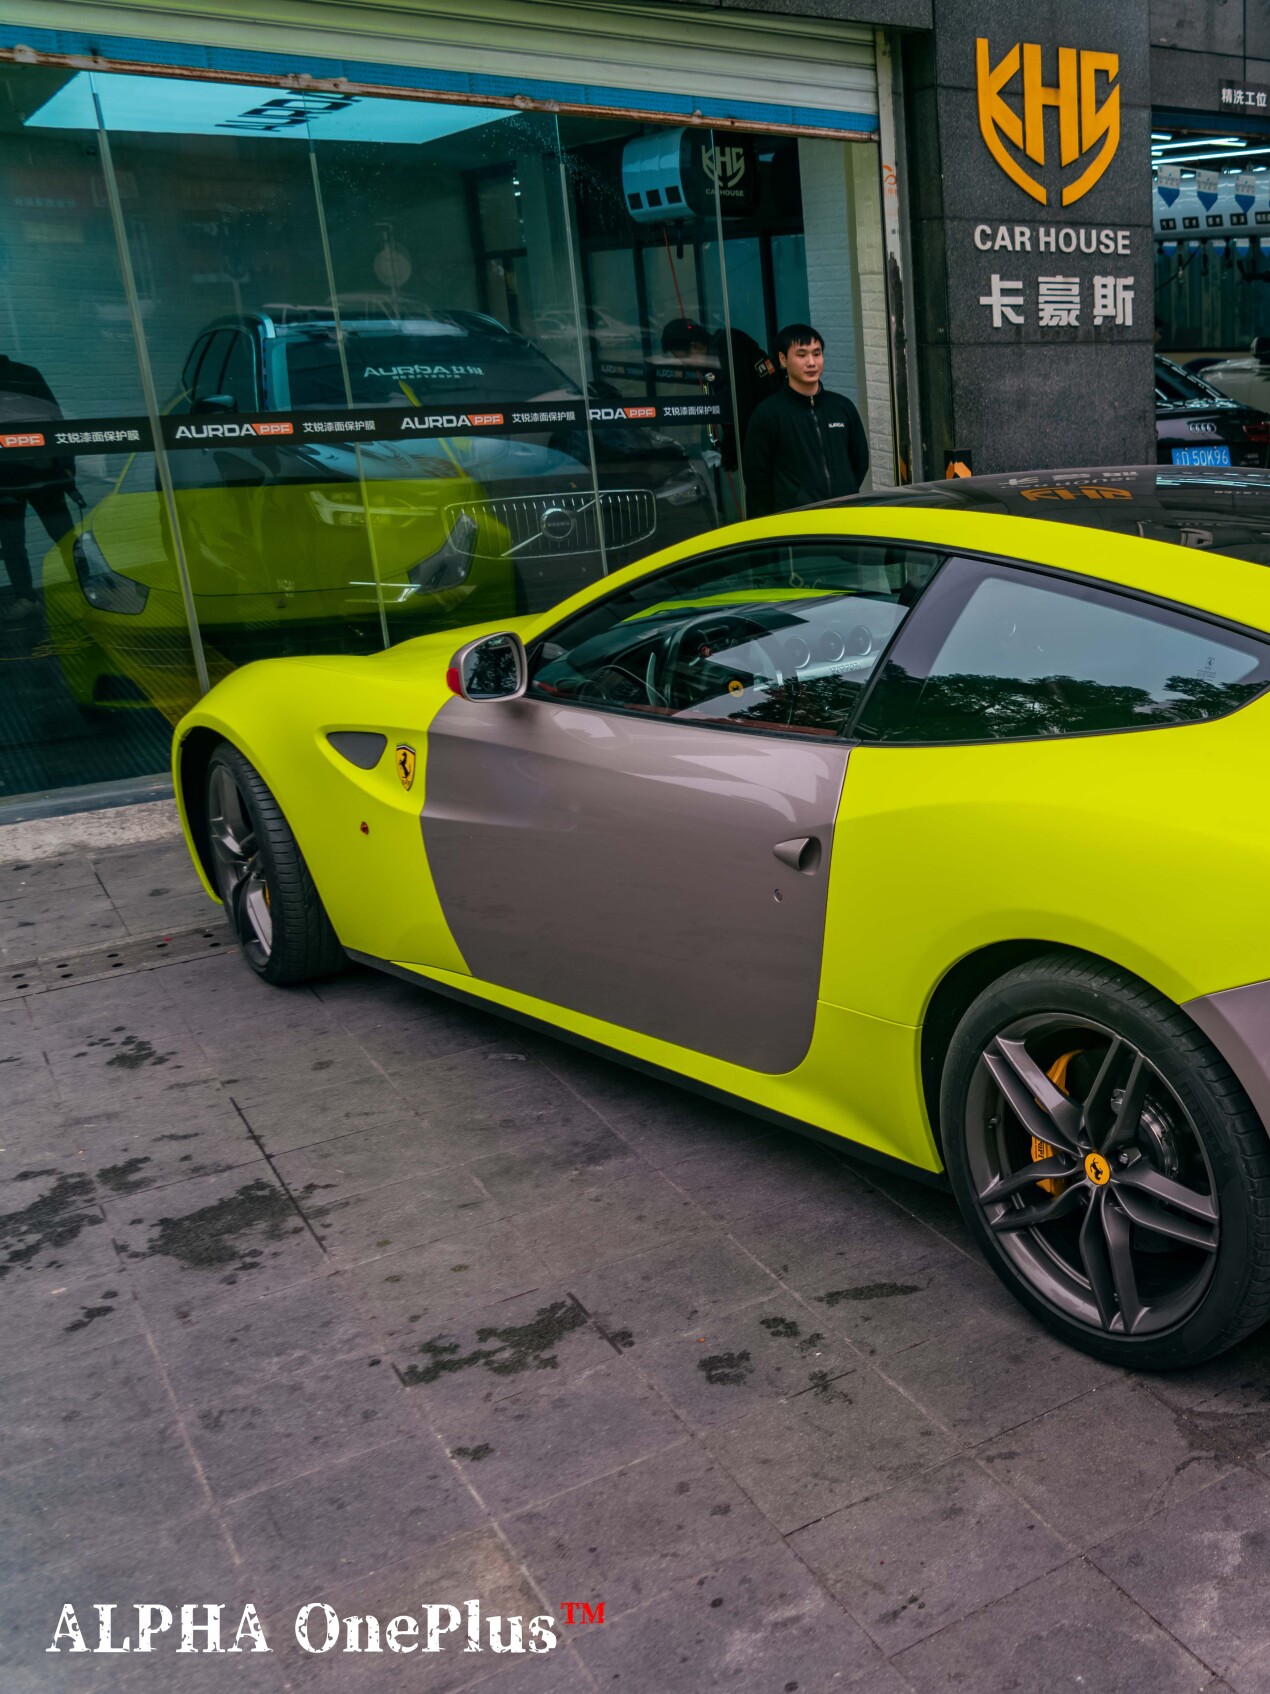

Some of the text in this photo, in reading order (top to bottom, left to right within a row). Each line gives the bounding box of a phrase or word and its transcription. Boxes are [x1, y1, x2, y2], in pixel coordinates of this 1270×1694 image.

[973, 224, 1131, 255] CAR HOUSE
[979, 273, 1135, 328] 卡豪斯
[363, 364, 450, 378] AURDA
[400, 411, 577, 430] AURDA PPF 艾锐漆面保护膜
[629, 407, 655, 418] PPF
[663, 405, 721, 417] 艾锐漆面保护膜
[4, 429, 141, 447] PPF 艾锐漆面保护膜
[175, 420, 376, 440] AURDA PPF 艾锐漆面保护膜
